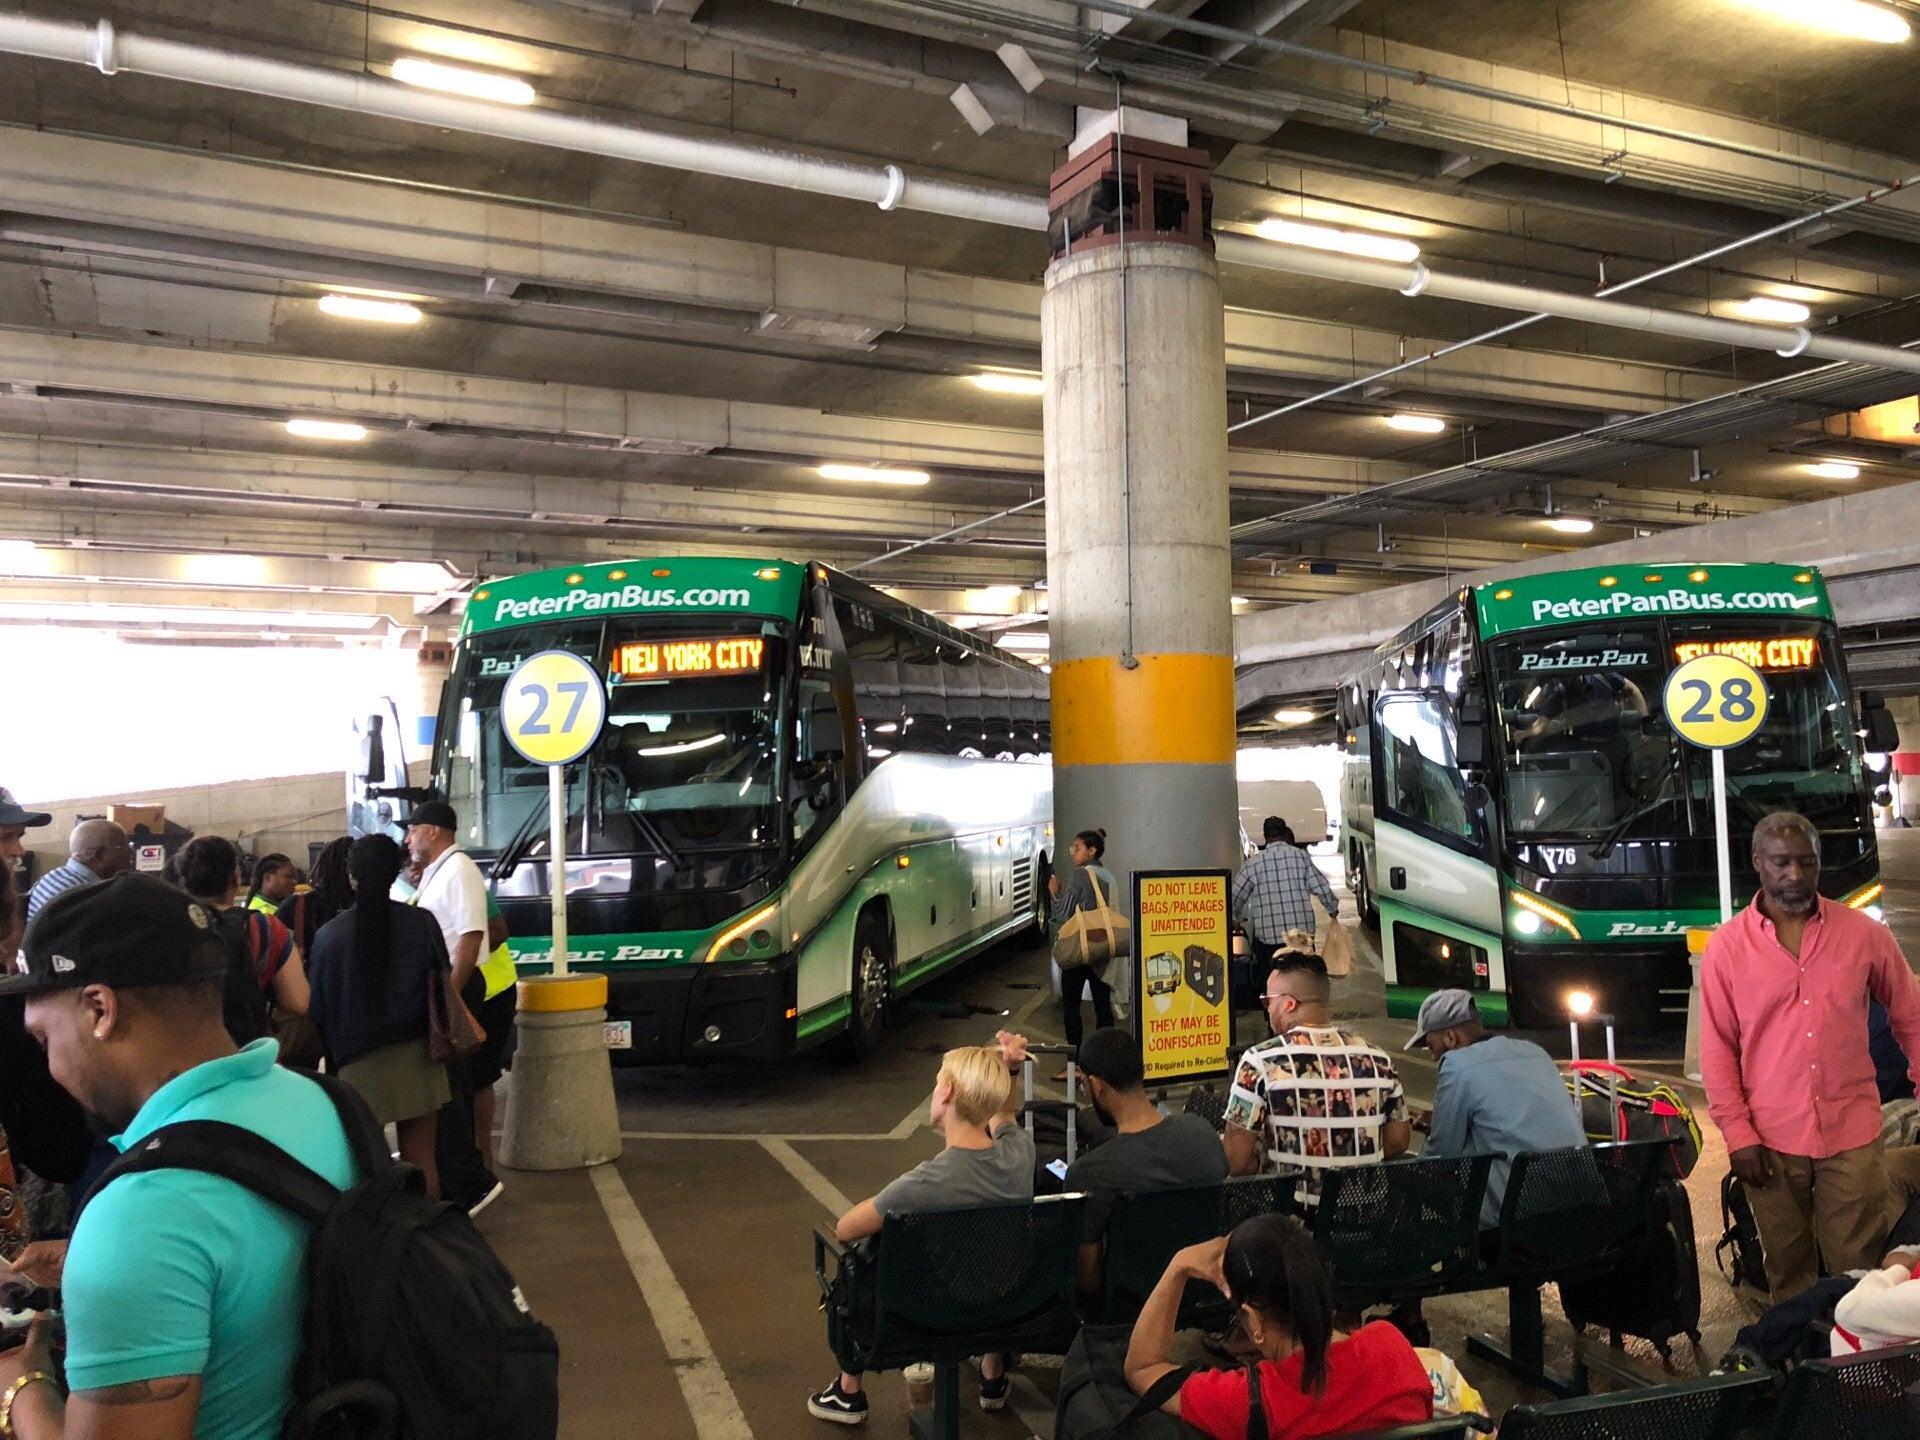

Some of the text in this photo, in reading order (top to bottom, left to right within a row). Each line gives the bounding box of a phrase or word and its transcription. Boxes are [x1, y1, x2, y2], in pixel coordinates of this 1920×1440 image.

[495, 585, 750, 621] PeterPanBus.com
[1532, 589, 1795, 621] PeterPanBus.com
[621, 639, 763, 674] NEW YORK CITY
[1518, 650, 1649, 671] Peter Pan
[1766, 638, 1815, 667] CITY
[519, 681, 589, 736] 27
[1680, 677, 1756, 723] 28
[1148, 882, 1218, 896] DO NOT LEAVE
[1142, 900, 1224, 914] BAGS/PACKAGES
[1151, 917, 1216, 932] UNATTENDED
[1607, 921, 1689, 937] Pet
[611, 945, 684, 961] Pan
[1150, 1015, 1220, 1033] THEY MAY BE
[1149, 1033, 1222, 1051] CONFISCATED
[1154, 1060, 1185, 1072] Required
[1186, 1059, 1194, 1067] to
